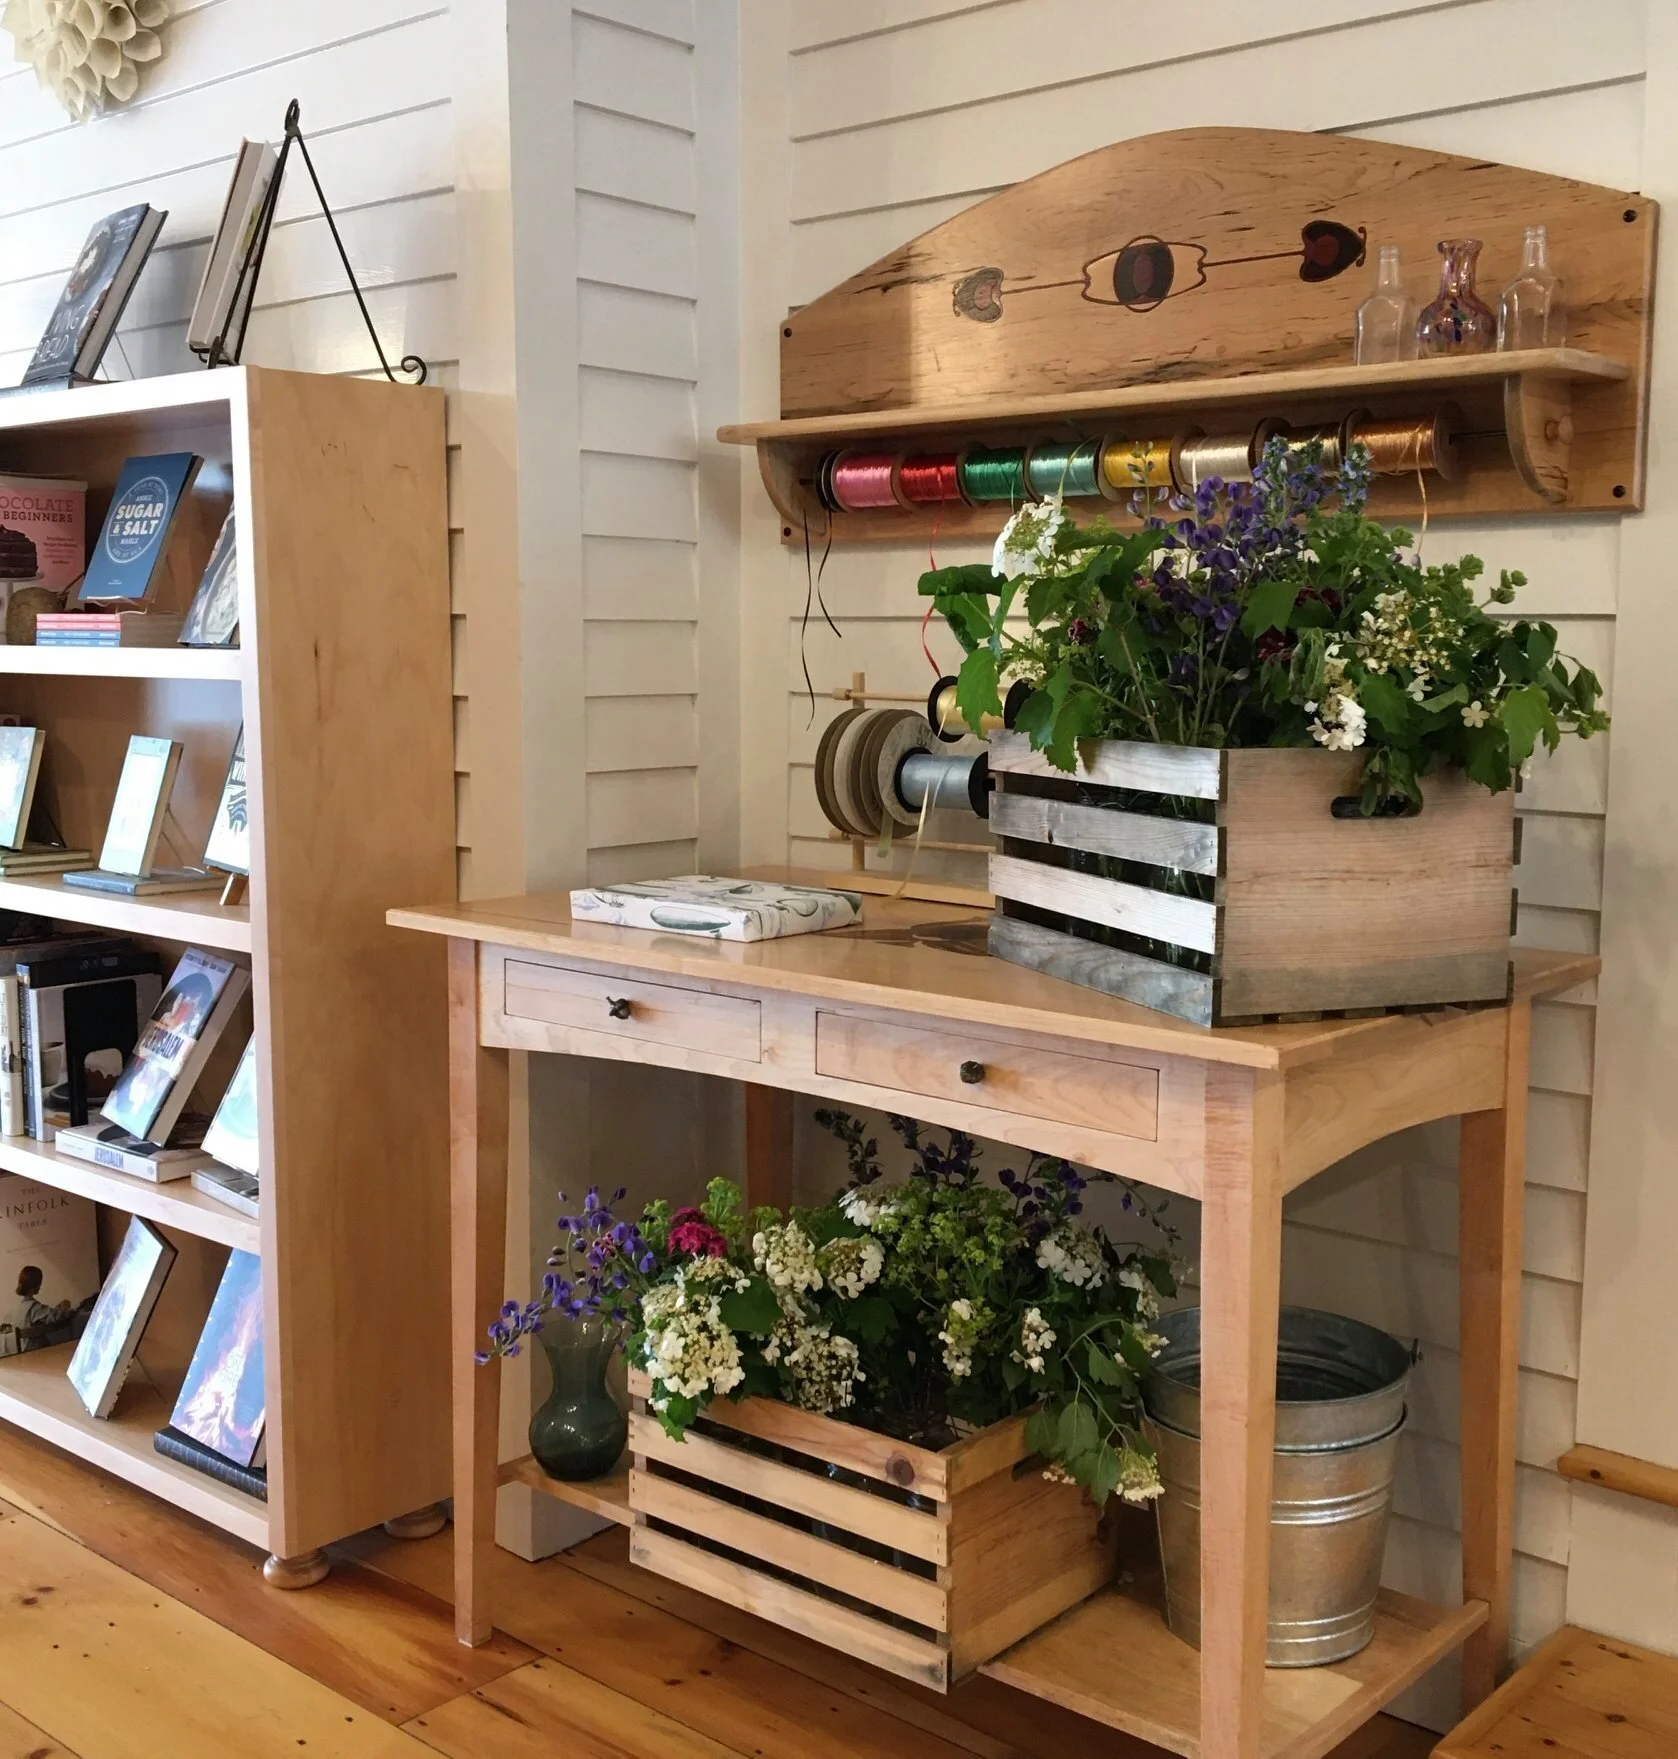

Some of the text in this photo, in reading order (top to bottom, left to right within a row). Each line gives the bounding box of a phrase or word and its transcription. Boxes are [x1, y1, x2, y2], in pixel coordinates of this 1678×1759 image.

[4, 511, 72, 523] BEGINNERS
[116, 503, 164, 519] SUGAR
[113, 520, 159, 536] & SALT
[141, 1027, 185, 1061] JERUSALEM
[95, 1147, 124, 1169] JERUSALEM
[0, 1196, 69, 1219] INFOLK
